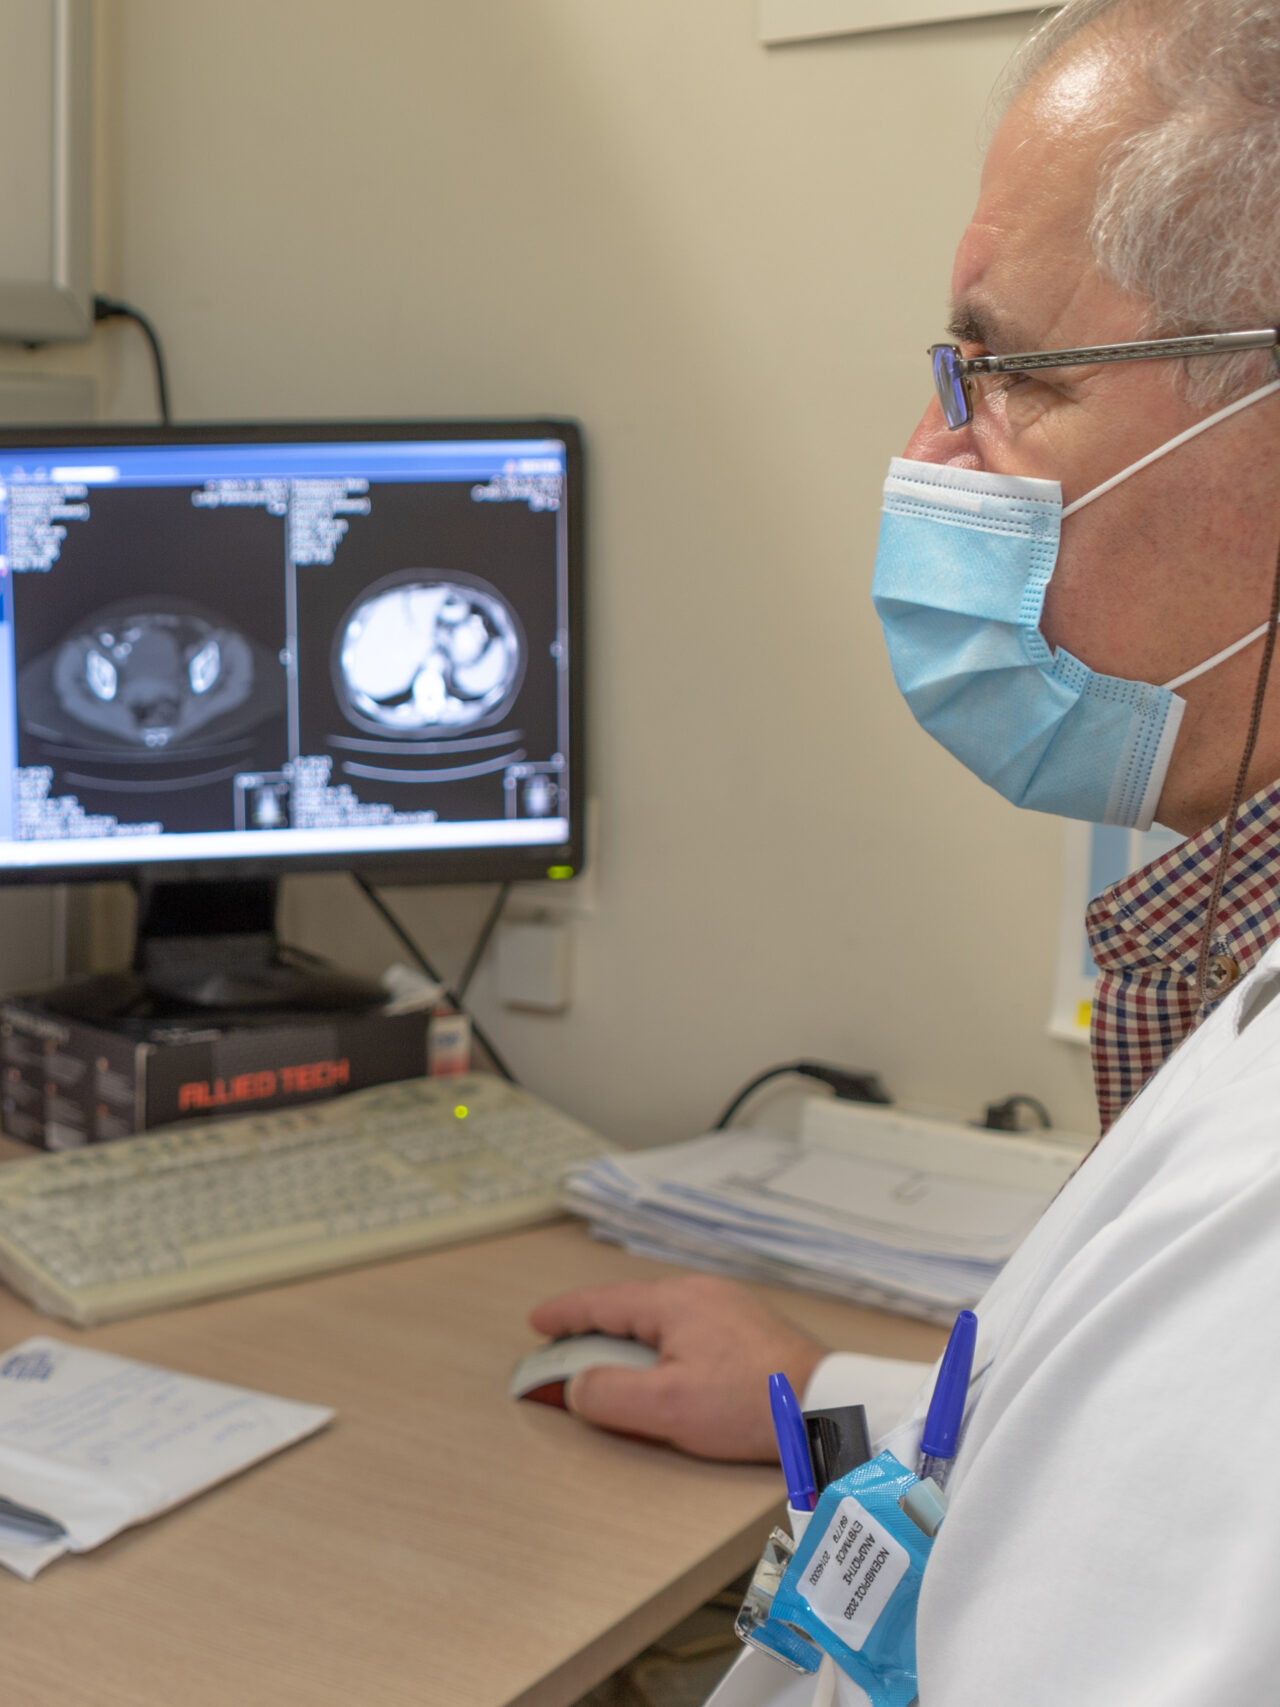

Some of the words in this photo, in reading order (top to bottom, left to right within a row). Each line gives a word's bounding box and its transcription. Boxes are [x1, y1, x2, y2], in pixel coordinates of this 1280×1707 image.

[178, 1069, 277, 1111] ALLIED
[279, 1057, 350, 1094] TECH
[854, 1547, 890, 1602] ΝΟΕΜΒΡΙΟΣ
[843, 1598, 859, 1620] 2020
